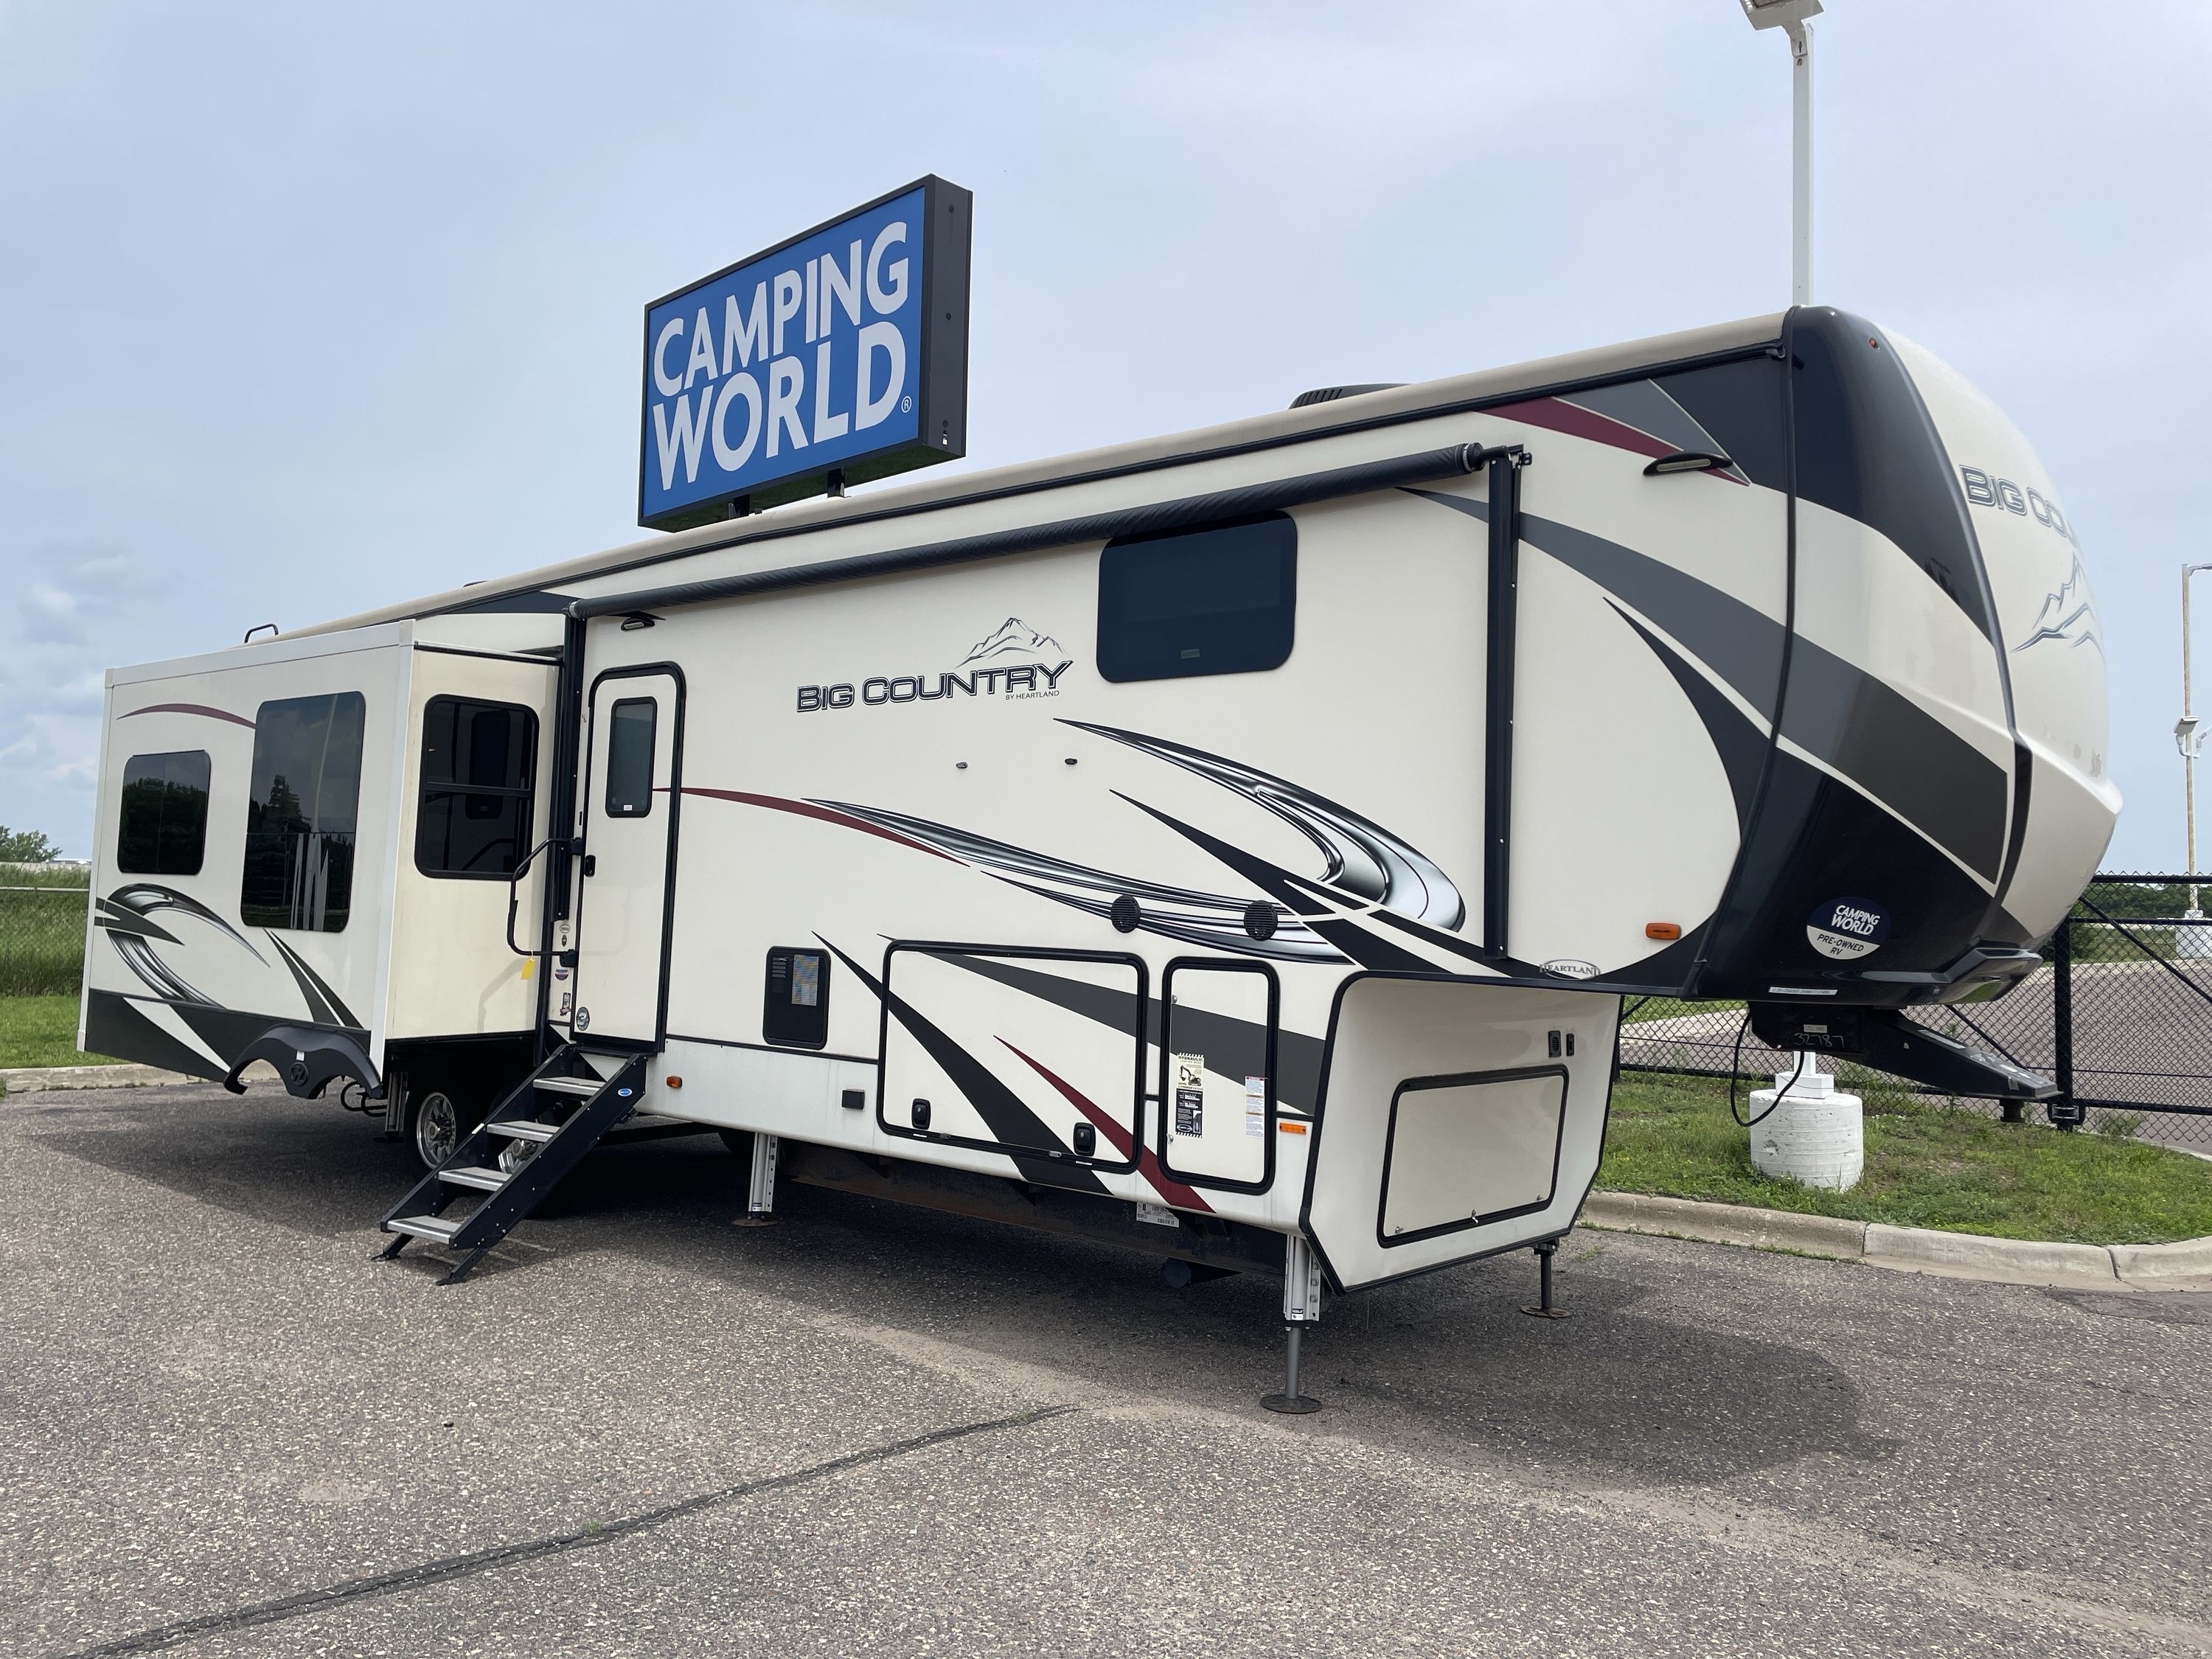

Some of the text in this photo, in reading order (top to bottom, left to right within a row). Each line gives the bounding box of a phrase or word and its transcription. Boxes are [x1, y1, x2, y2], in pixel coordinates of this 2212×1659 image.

[653, 221, 909, 397] CAMPING
[1958, 464, 2028, 517] BIG
[796, 661, 1074, 712] BIG COUNTRY
[1016, 690, 1060, 700] HEARTLAND
[1831, 914, 1874, 936] WORLD
[1835, 905, 1881, 926] CAMPING
[1816, 933, 1865, 952] PRE-OWNED
[1829, 947, 1843, 956] RV
[1539, 964, 1601, 977] HEARTLAND
[1794, 1032, 1845, 1048] 32787
